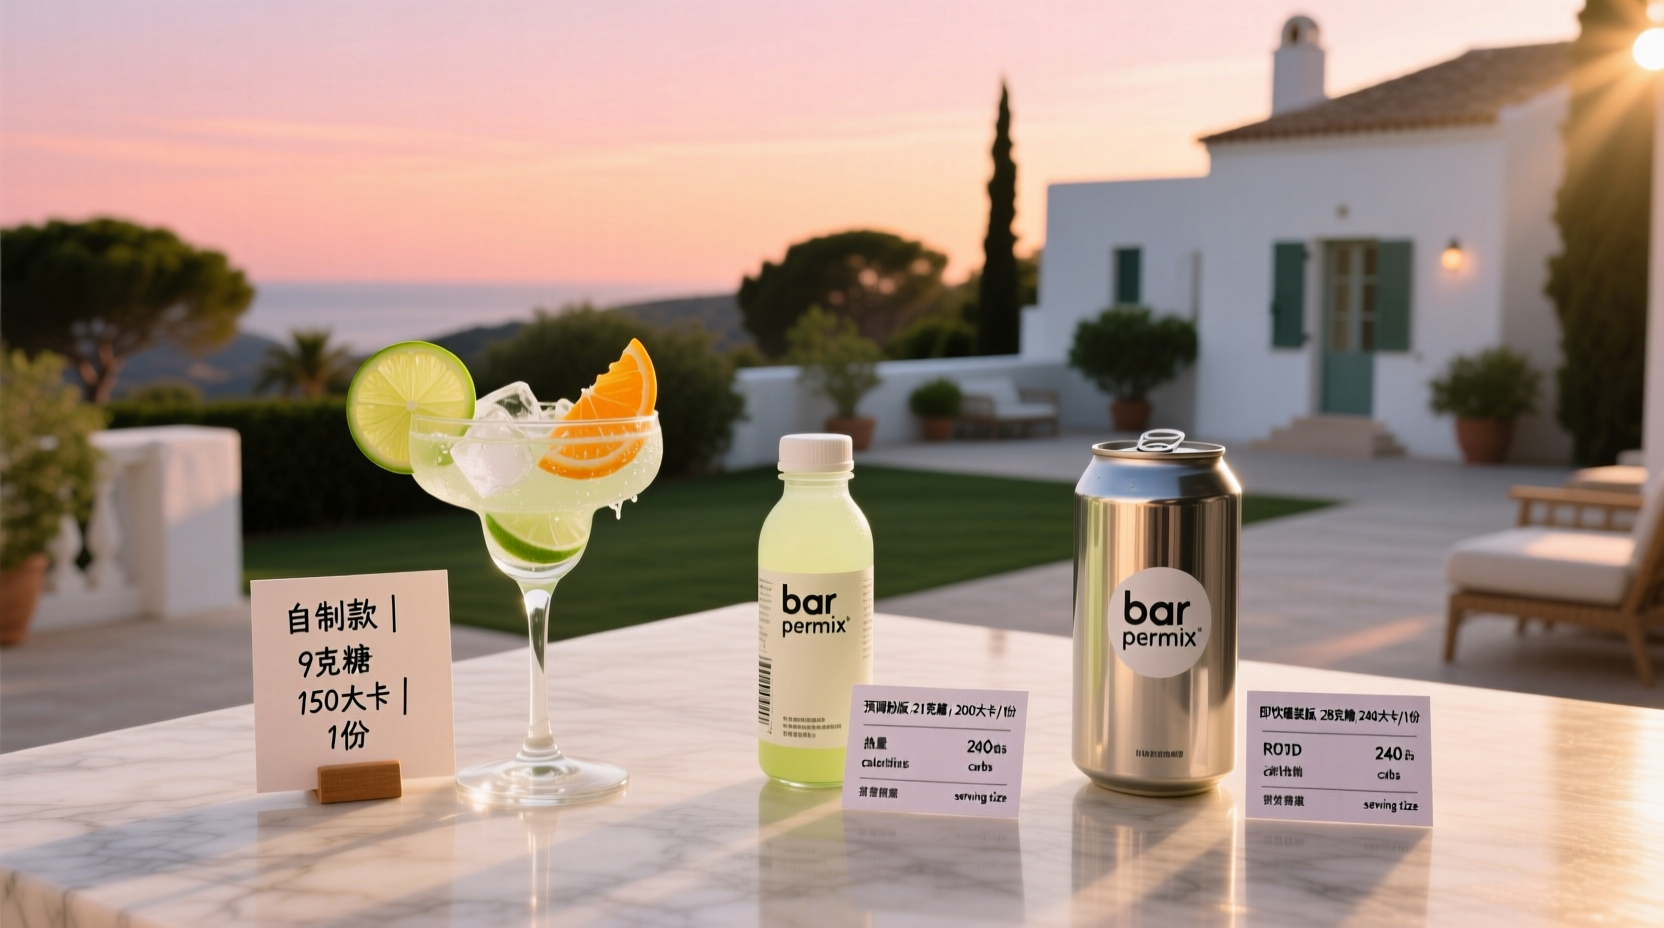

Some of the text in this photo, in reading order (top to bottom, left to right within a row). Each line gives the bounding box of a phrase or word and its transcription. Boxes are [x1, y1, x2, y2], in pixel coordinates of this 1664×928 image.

[782, 583, 837, 615] bar
[1124, 590, 1190, 626] bar
[288, 598, 378, 635] 自制款
[782, 615, 847, 638] permix
[1122, 627, 1197, 651] permix
[298, 643, 373, 678] 9克糖
[298, 681, 391, 715] 150大卡
[328, 720, 370, 751] 1份
